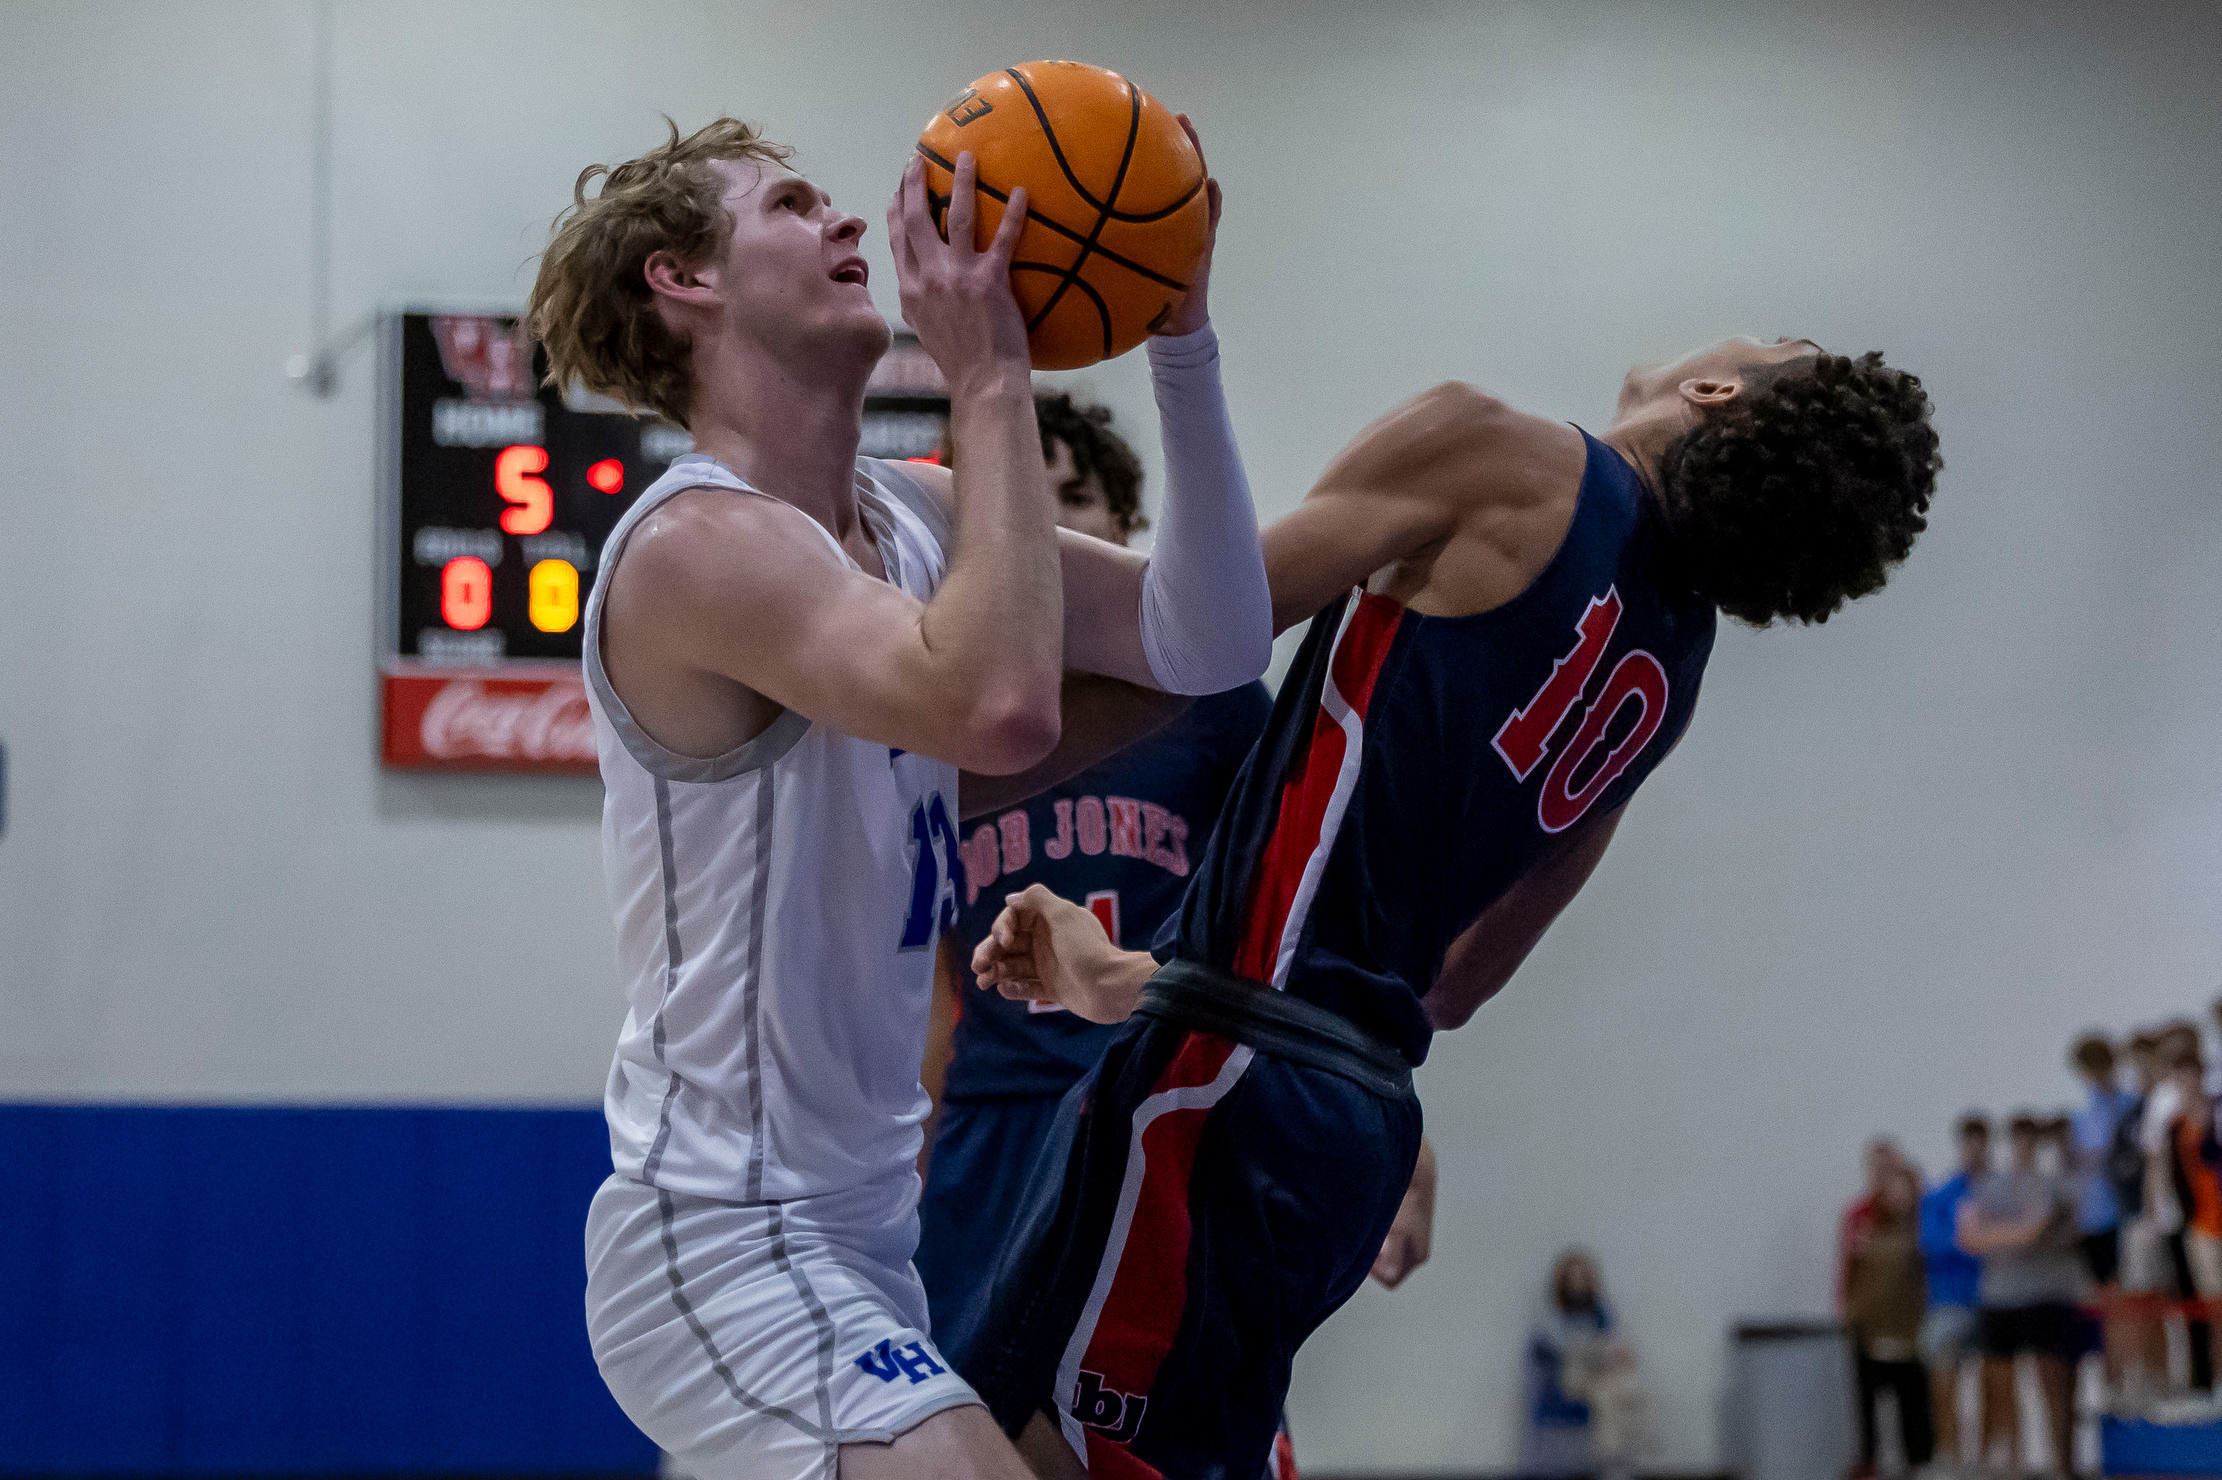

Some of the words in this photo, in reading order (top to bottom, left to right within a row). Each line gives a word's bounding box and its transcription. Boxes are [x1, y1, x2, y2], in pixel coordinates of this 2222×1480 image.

[495, 445, 555, 535] 5
[441, 557, 492, 630] 0
[529, 559, 579, 633] 0
[1490, 583, 1669, 834] 10
[1045, 796, 1190, 877] JONES
[855, 1339, 946, 1385] VH
